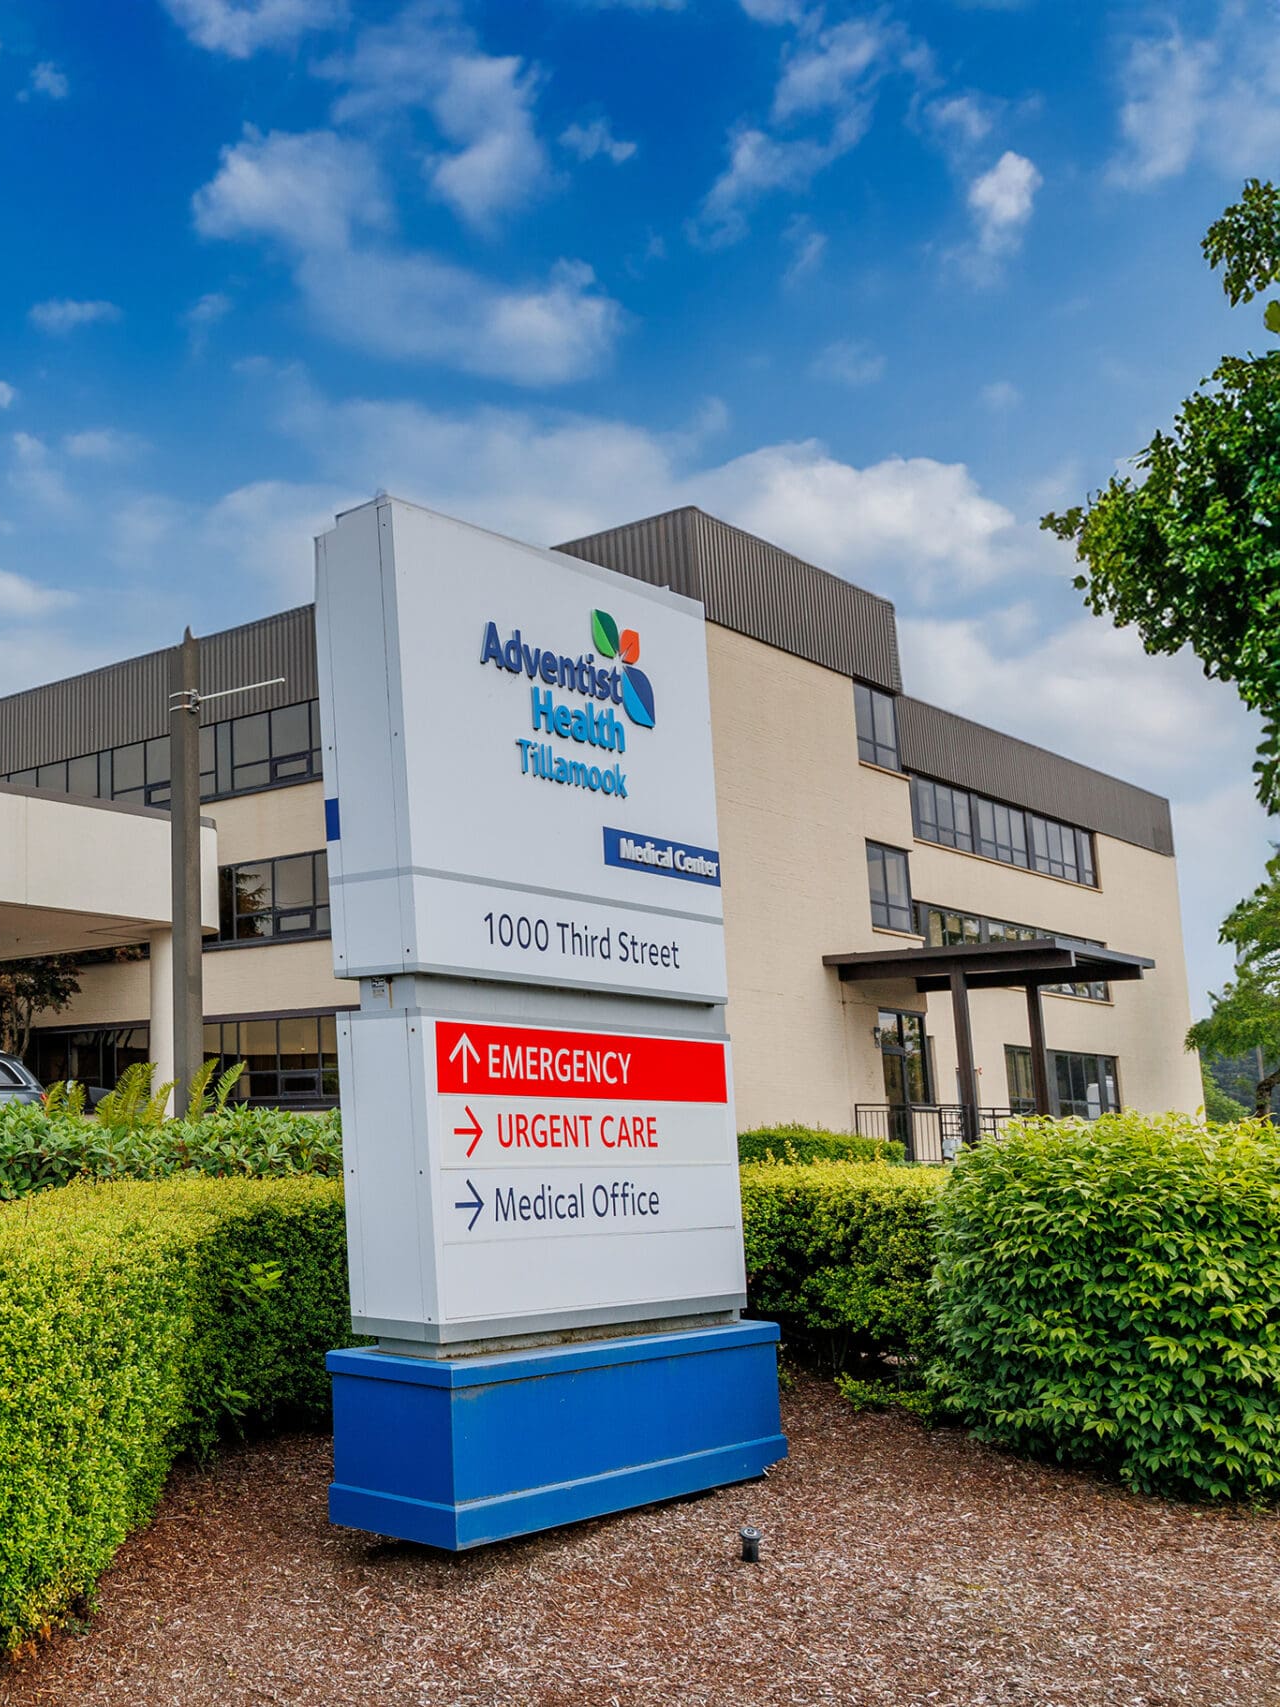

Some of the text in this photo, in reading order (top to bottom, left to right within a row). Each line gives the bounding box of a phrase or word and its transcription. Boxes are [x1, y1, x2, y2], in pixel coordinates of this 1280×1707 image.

[480, 621, 623, 705] Adventist
[531, 685, 626, 753] Health
[515, 738, 628, 799] Tillamook
[620, 837, 719, 878] Medical Center
[484, 912, 680, 969] 1000 Third Street
[488, 1043, 632, 1085] EMERGENCY
[497, 1113, 659, 1148] URGENT CARE
[495, 1181, 660, 1222] Medical Office
